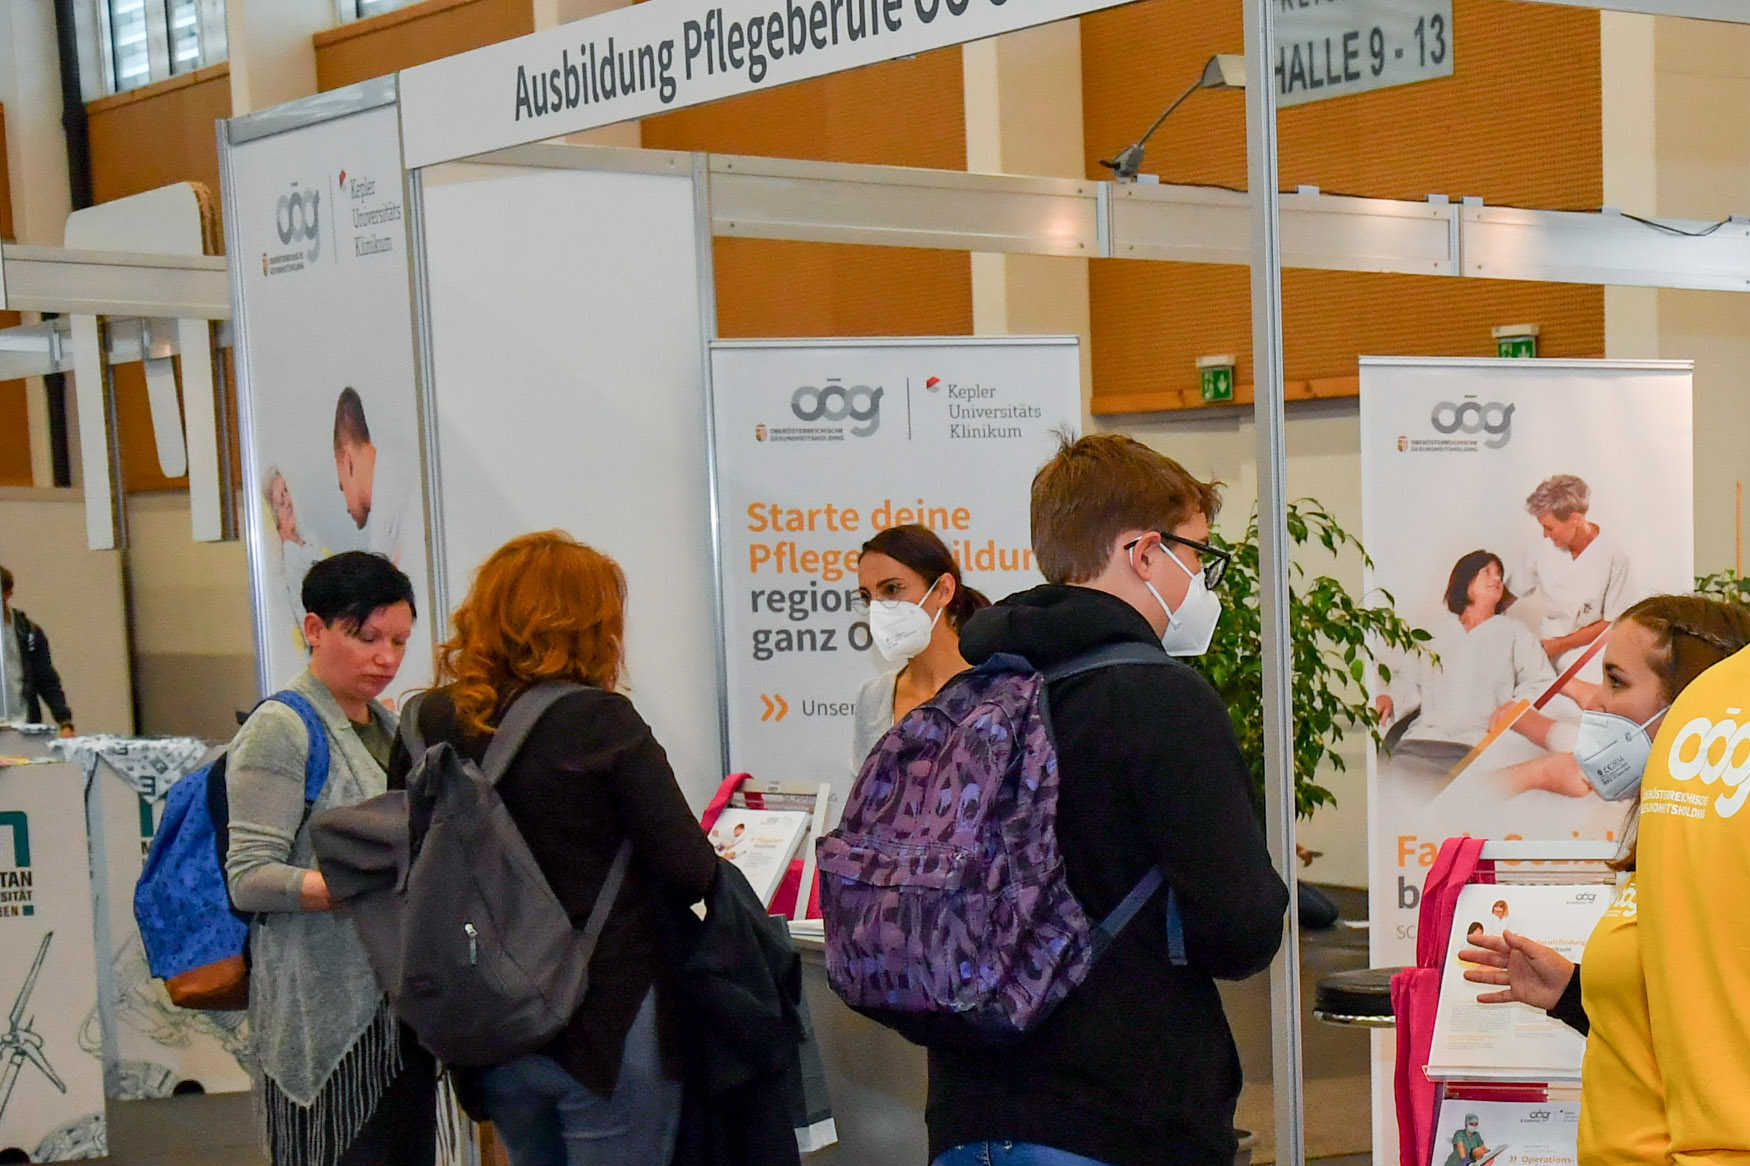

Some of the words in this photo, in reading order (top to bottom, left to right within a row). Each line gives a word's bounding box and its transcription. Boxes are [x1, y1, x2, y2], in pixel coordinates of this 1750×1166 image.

[1370, 26, 1385, 76] 9
[1414, 14, 1447, 67] 13
[515, 36, 677, 121] Ausbildung
[948, 384, 996, 403] Kepler
[949, 404, 1042, 420] Universitäts
[950, 423, 1023, 439] Klinikum
[747, 501, 860, 532] Starte
[871, 499, 970, 531] deine
[751, 626, 838, 661] ganz
[848, 621, 873, 652] O
